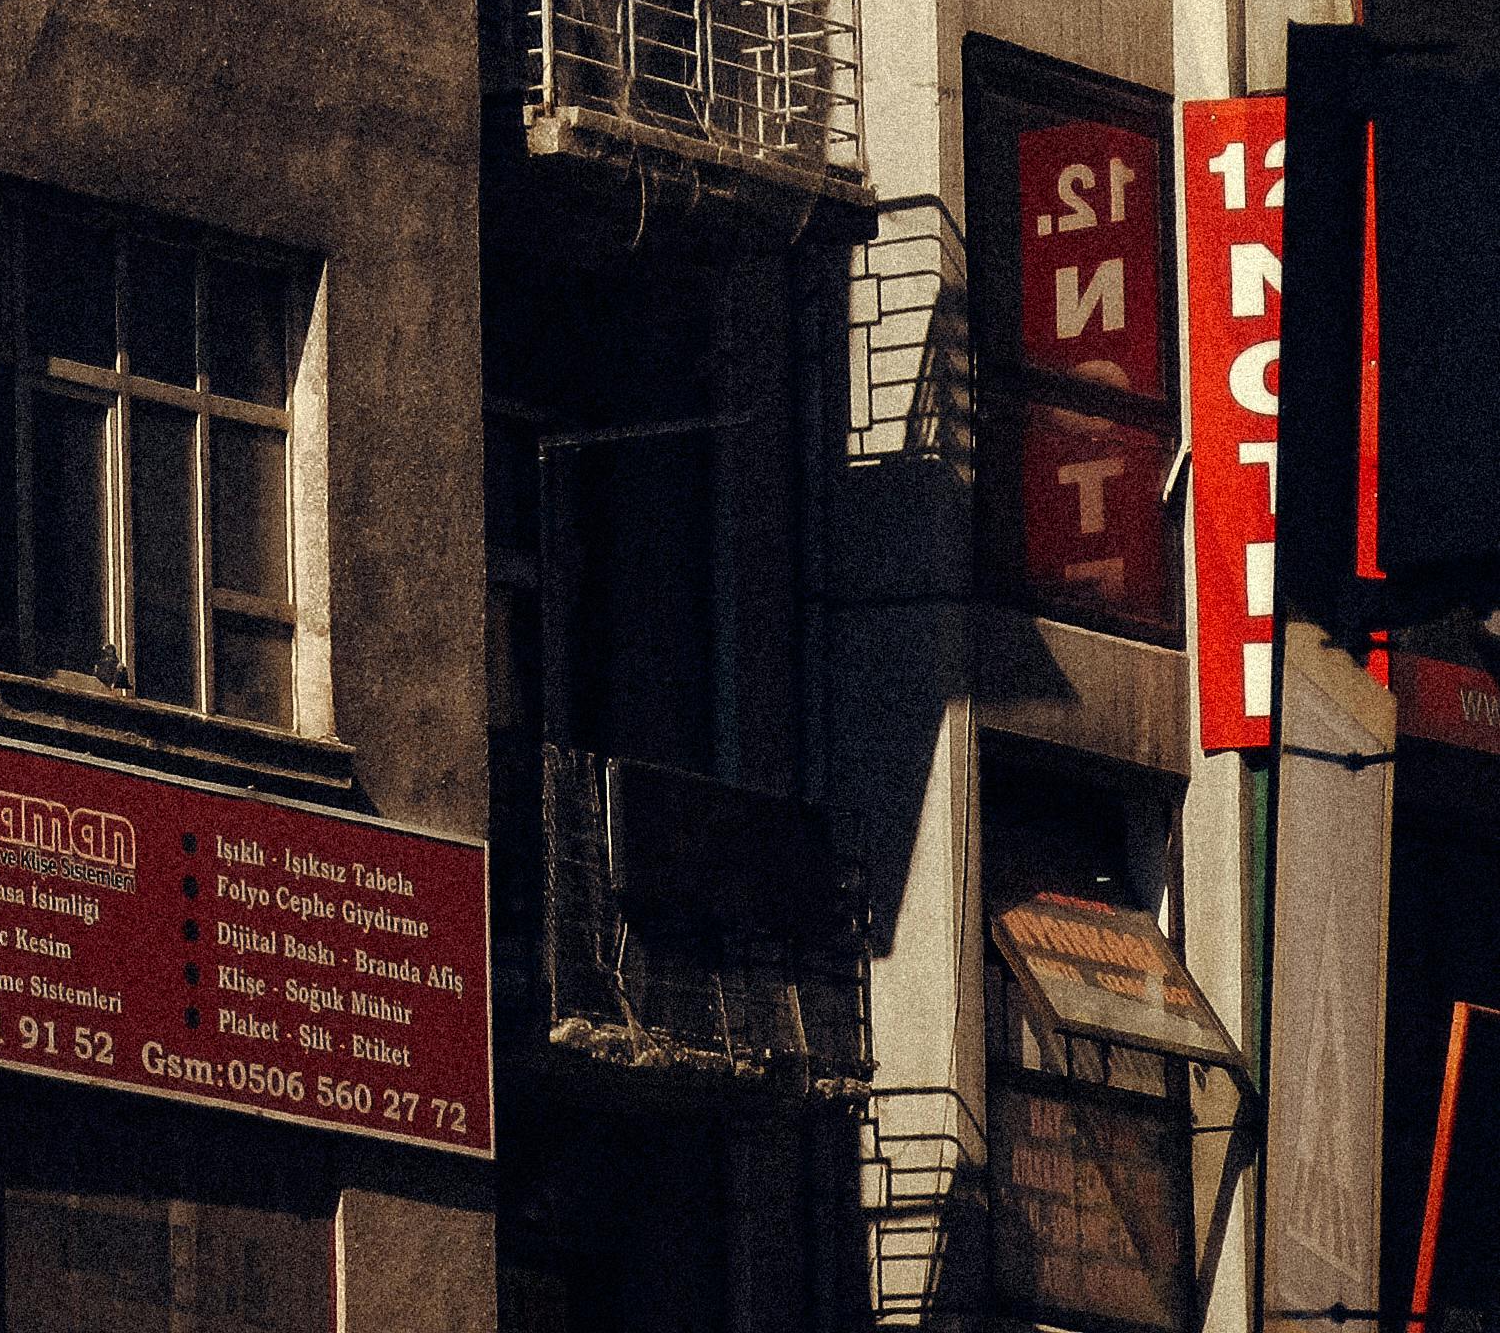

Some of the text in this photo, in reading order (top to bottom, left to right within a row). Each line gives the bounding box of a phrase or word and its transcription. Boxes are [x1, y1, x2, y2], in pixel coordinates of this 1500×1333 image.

[0, 851, 17, 867] ve
[61, 857, 136, 895] Sistemleri
[353, 862, 415, 897] Tabela
[31, 880, 100, 926] İsimliği
[217, 874, 430, 939] Folyo Cephe Giydirme
[14, 926, 73, 960] Kesim
[217, 921, 277, 956] Dijital
[283, 933, 336, 967] Baskı
[355, 948, 422, 983] Branda
[427, 964, 464, 1000] Afiş
[30, 974, 122, 1014] Sistemleri
[217, 964, 266, 1001] Klişe
[285, 978, 346, 1013] Soğuk
[351, 990, 413, 1026] Mühür
[218, 1008, 280, 1043] Plaket
[299, 1023, 333, 1055] Şilt
[353, 1034, 411, 1068] Etiket
[18, 1015, 59, 1055] 91
[74, 1026, 115, 1066] 52
[316, 1074, 373, 1114] 560
[383, 1089, 420, 1122] 27
[430, 1097, 467, 1134] 72
